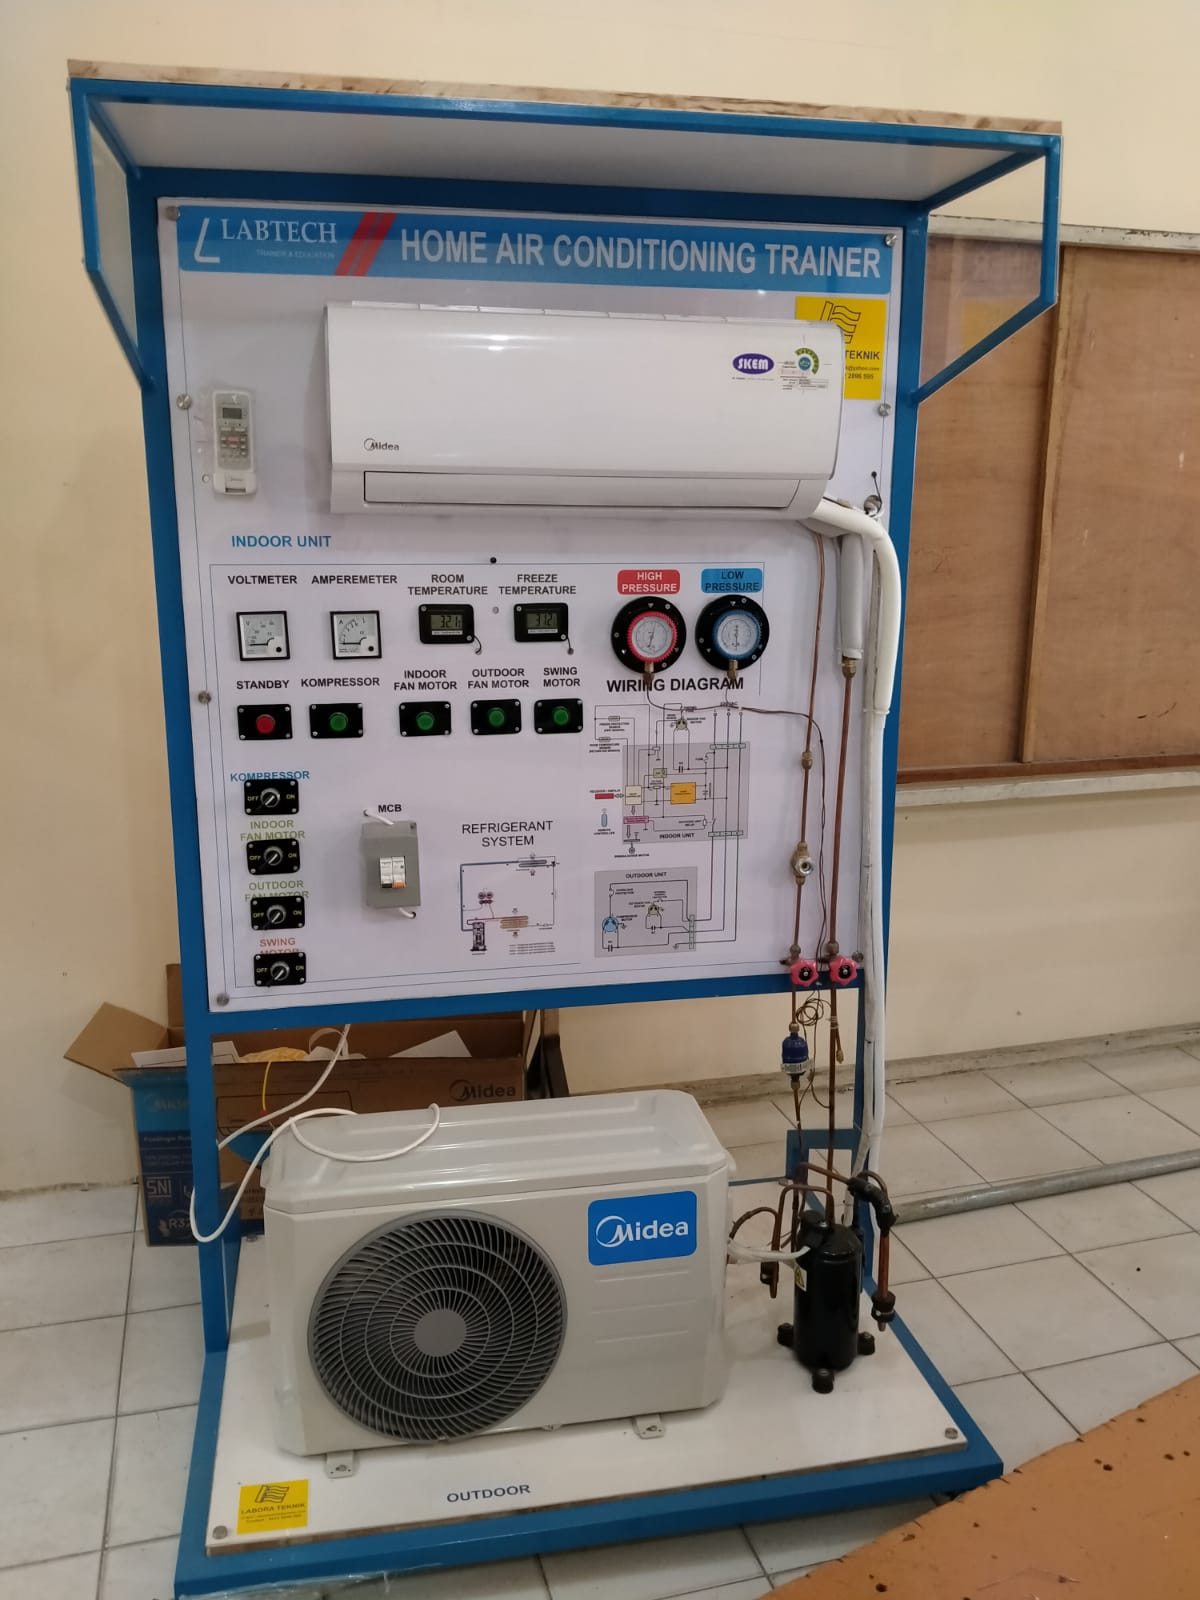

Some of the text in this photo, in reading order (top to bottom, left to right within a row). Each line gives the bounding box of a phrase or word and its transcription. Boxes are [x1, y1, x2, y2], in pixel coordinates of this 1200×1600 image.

[222, 218, 337, 243] LABTECH
[402, 228, 880, 278] HOME AIR CONDITIONING TRAINER
[738, 358, 769, 370] SKEM
[364, 438, 400, 451] Midea
[232, 536, 332, 548] INDOOR UNIT
[228, 575, 297, 584] VOLTMETER
[312, 575, 398, 584] AMPEREMETER
[432, 574, 464, 583] ROOM
[518, 574, 558, 582] FREEZE
[637, 572, 662, 581] HIGH
[721, 571, 744, 580] LOW
[408, 586, 488, 596] TEMPERATURE
[499, 586, 576, 594] TEMPERATURE
[622, 584, 677, 592] PRESSURE
[705, 582, 760, 591] PRESSURE
[404, 670, 446, 678] INDOOR
[472, 668, 525, 678] OUTDOOR
[544, 666, 578, 676] SWING
[236, 680, 290, 690] STANDBY
[301, 678, 380, 687] KOMPRESSOR
[394, 681, 457, 691] FAN MOTOR
[468, 679, 530, 689] FAN MOTOR
[544, 678, 580, 687] MOTOR
[670, 677, 744, 691] DIAGRAM
[230, 770, 310, 782] KOMPRESSOR
[378, 804, 402, 813] MCB
[250, 820, 294, 830] INDOOR
[462, 820, 554, 834] REFRIGERANT
[240, 831, 305, 842] FAN MOTOR
[482, 836, 534, 848] SYSTEM
[249, 880, 304, 890] OUTDOOR
[260, 938, 296, 947] SWING
[450, 1080, 516, 1100] Midea
[146, 1179, 172, 1195] SNI
[596, 1215, 689, 1248] Midea
[447, 1484, 531, 1504] OUTDOOR
